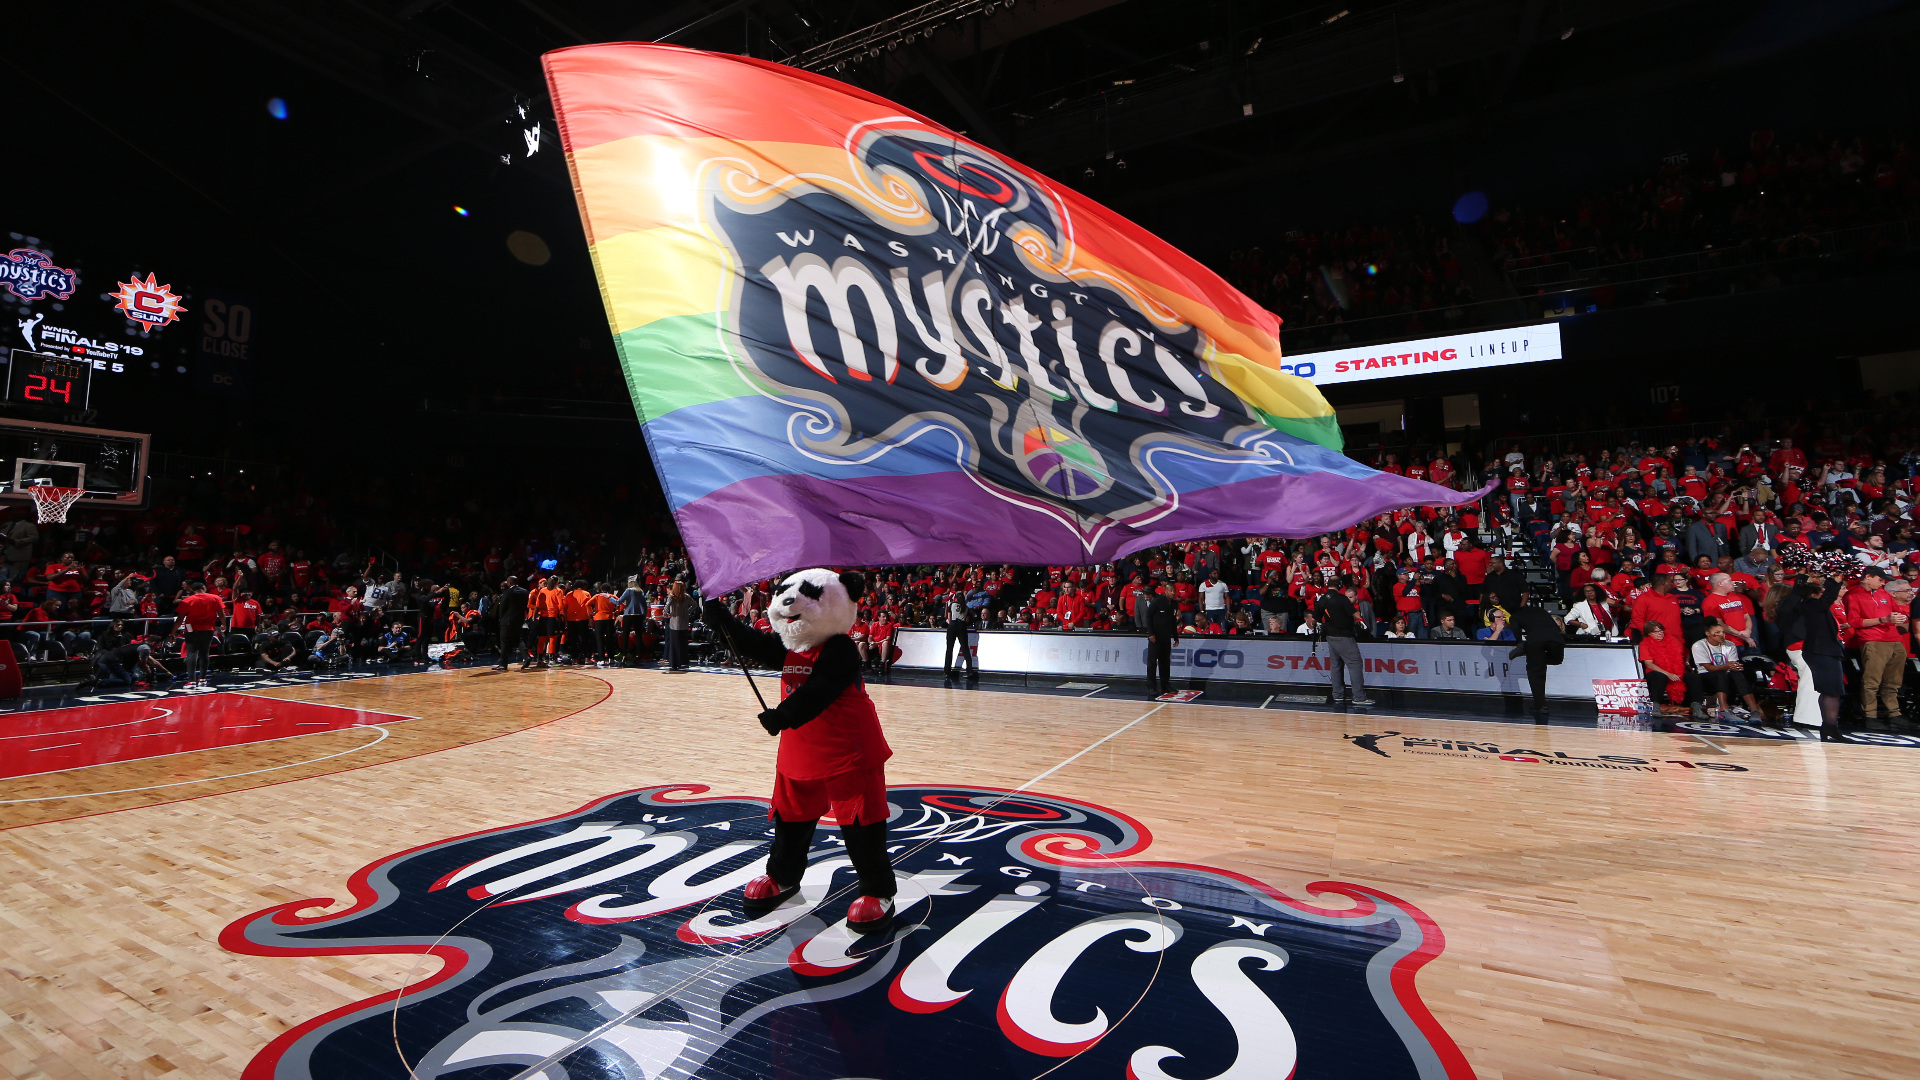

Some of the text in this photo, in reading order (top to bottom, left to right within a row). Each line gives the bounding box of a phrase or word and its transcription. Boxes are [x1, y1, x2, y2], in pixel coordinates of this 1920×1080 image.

[776, 229, 1155, 342] WASHINGT
[134, 291, 165, 314] C
[131, 311, 163, 323] SUN
[203, 298, 251, 343] SO
[42, 324, 78, 335] WNBA
[202, 336, 249, 360] CLOSE
[1334, 339, 1530, 373] STARTING LINEUP
[111, 362, 125, 373] 5
[24, 374, 72, 404] 24
[782, 665, 813, 675] GEICO
[1266, 654, 1419, 675] STAING
[1434, 660, 1509, 678] LINEUP
[1401, 736, 1501, 747] WNBA
[1402, 748, 1468, 758] Presented
[1542, 758, 1658, 773] YouTubeTV
